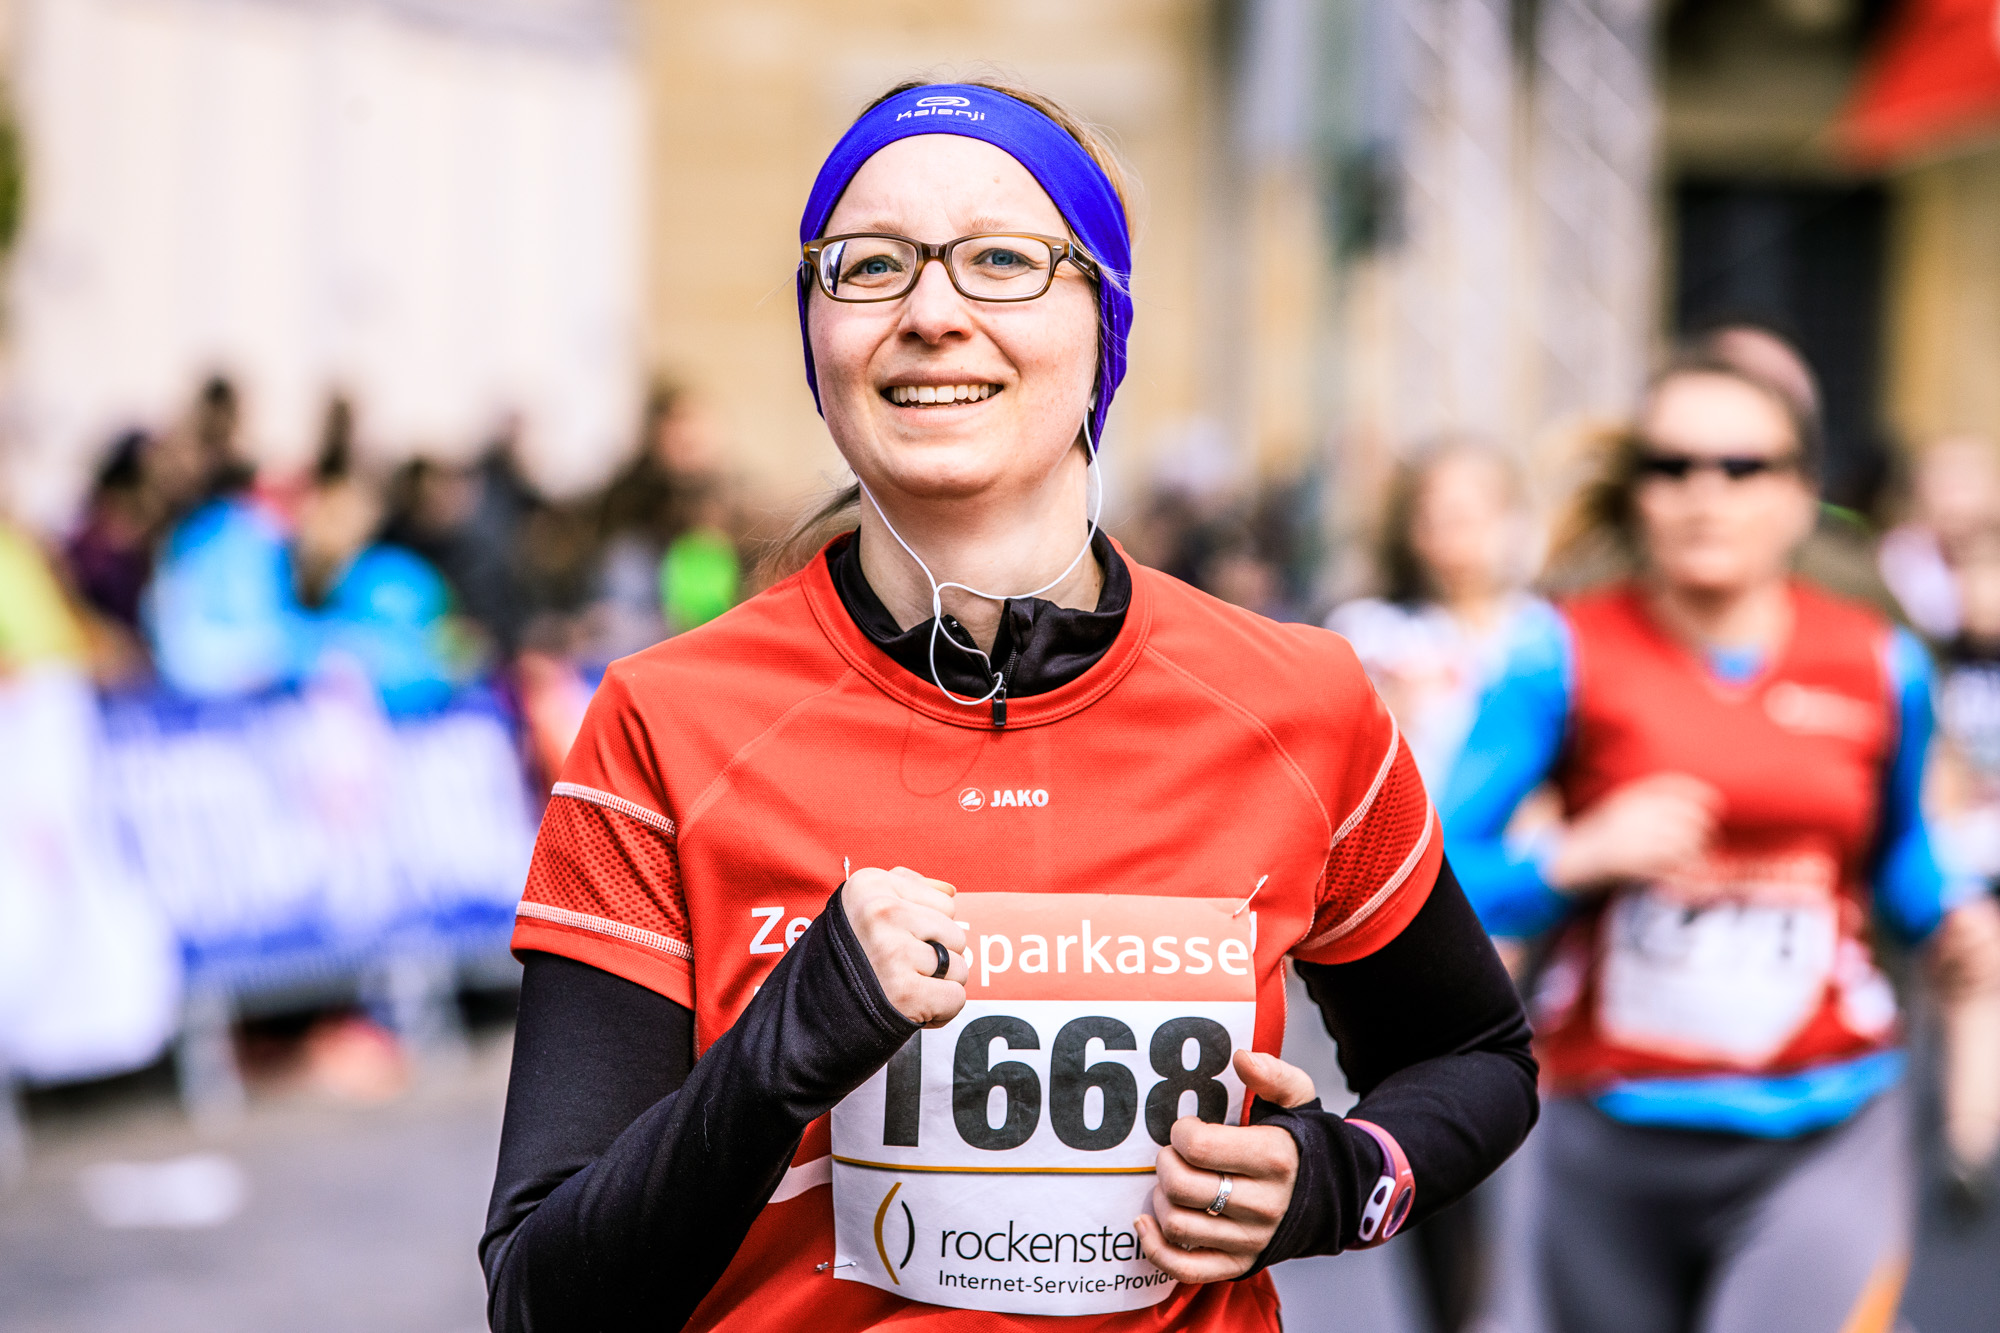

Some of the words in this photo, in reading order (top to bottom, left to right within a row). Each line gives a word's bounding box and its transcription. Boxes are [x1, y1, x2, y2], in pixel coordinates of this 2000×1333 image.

[990, 789, 1049, 807] JAKO
[883, 1015, 1232, 1151] 1668
[941, 1220, 1147, 1263] rockenstei
